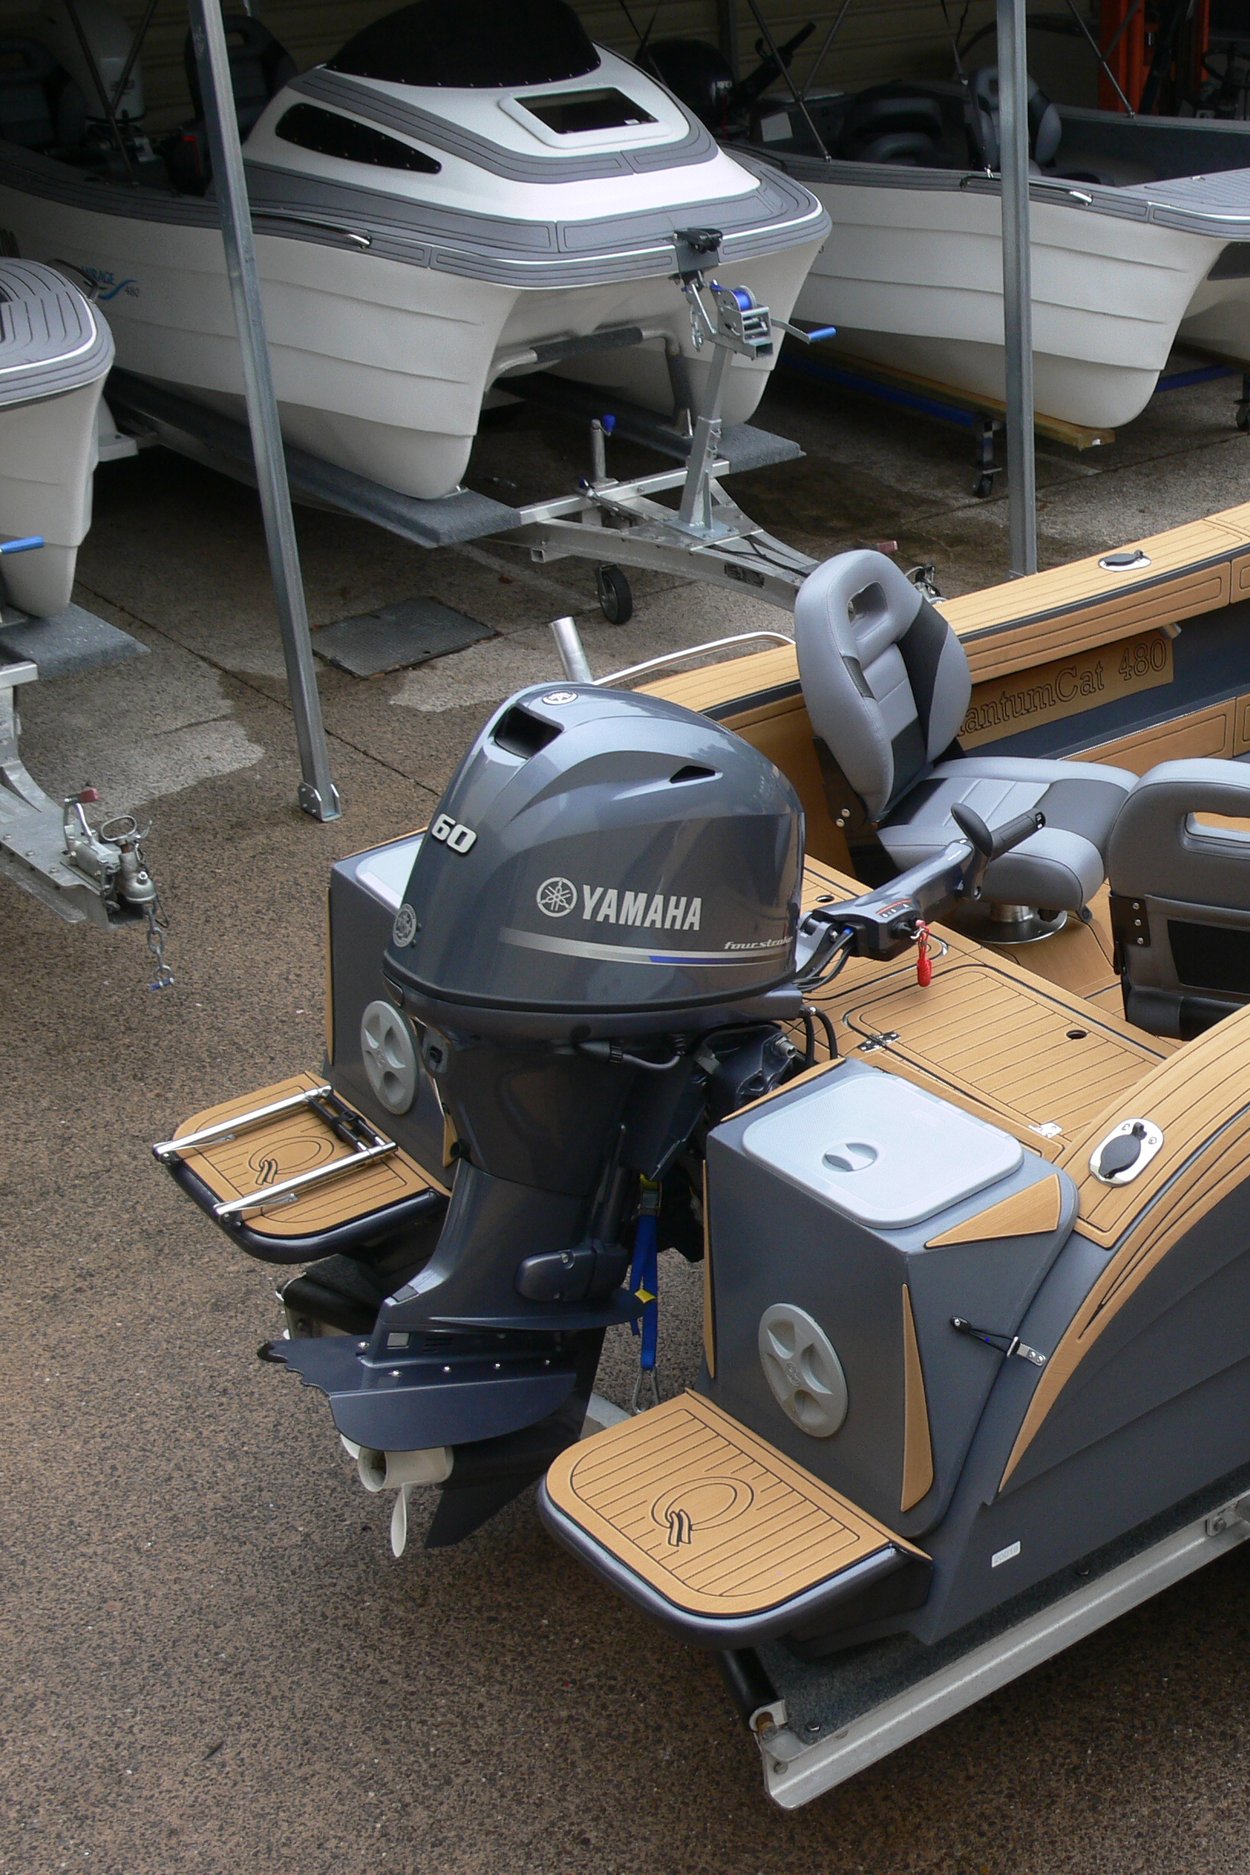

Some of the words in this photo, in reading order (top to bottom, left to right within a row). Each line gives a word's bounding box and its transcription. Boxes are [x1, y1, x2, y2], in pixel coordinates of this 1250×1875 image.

[956, 660, 1105, 737] antumCat
[1118, 638, 1167, 682] 480
[431, 812, 477, 854] 60
[581, 884, 702, 931] YAMAHA
